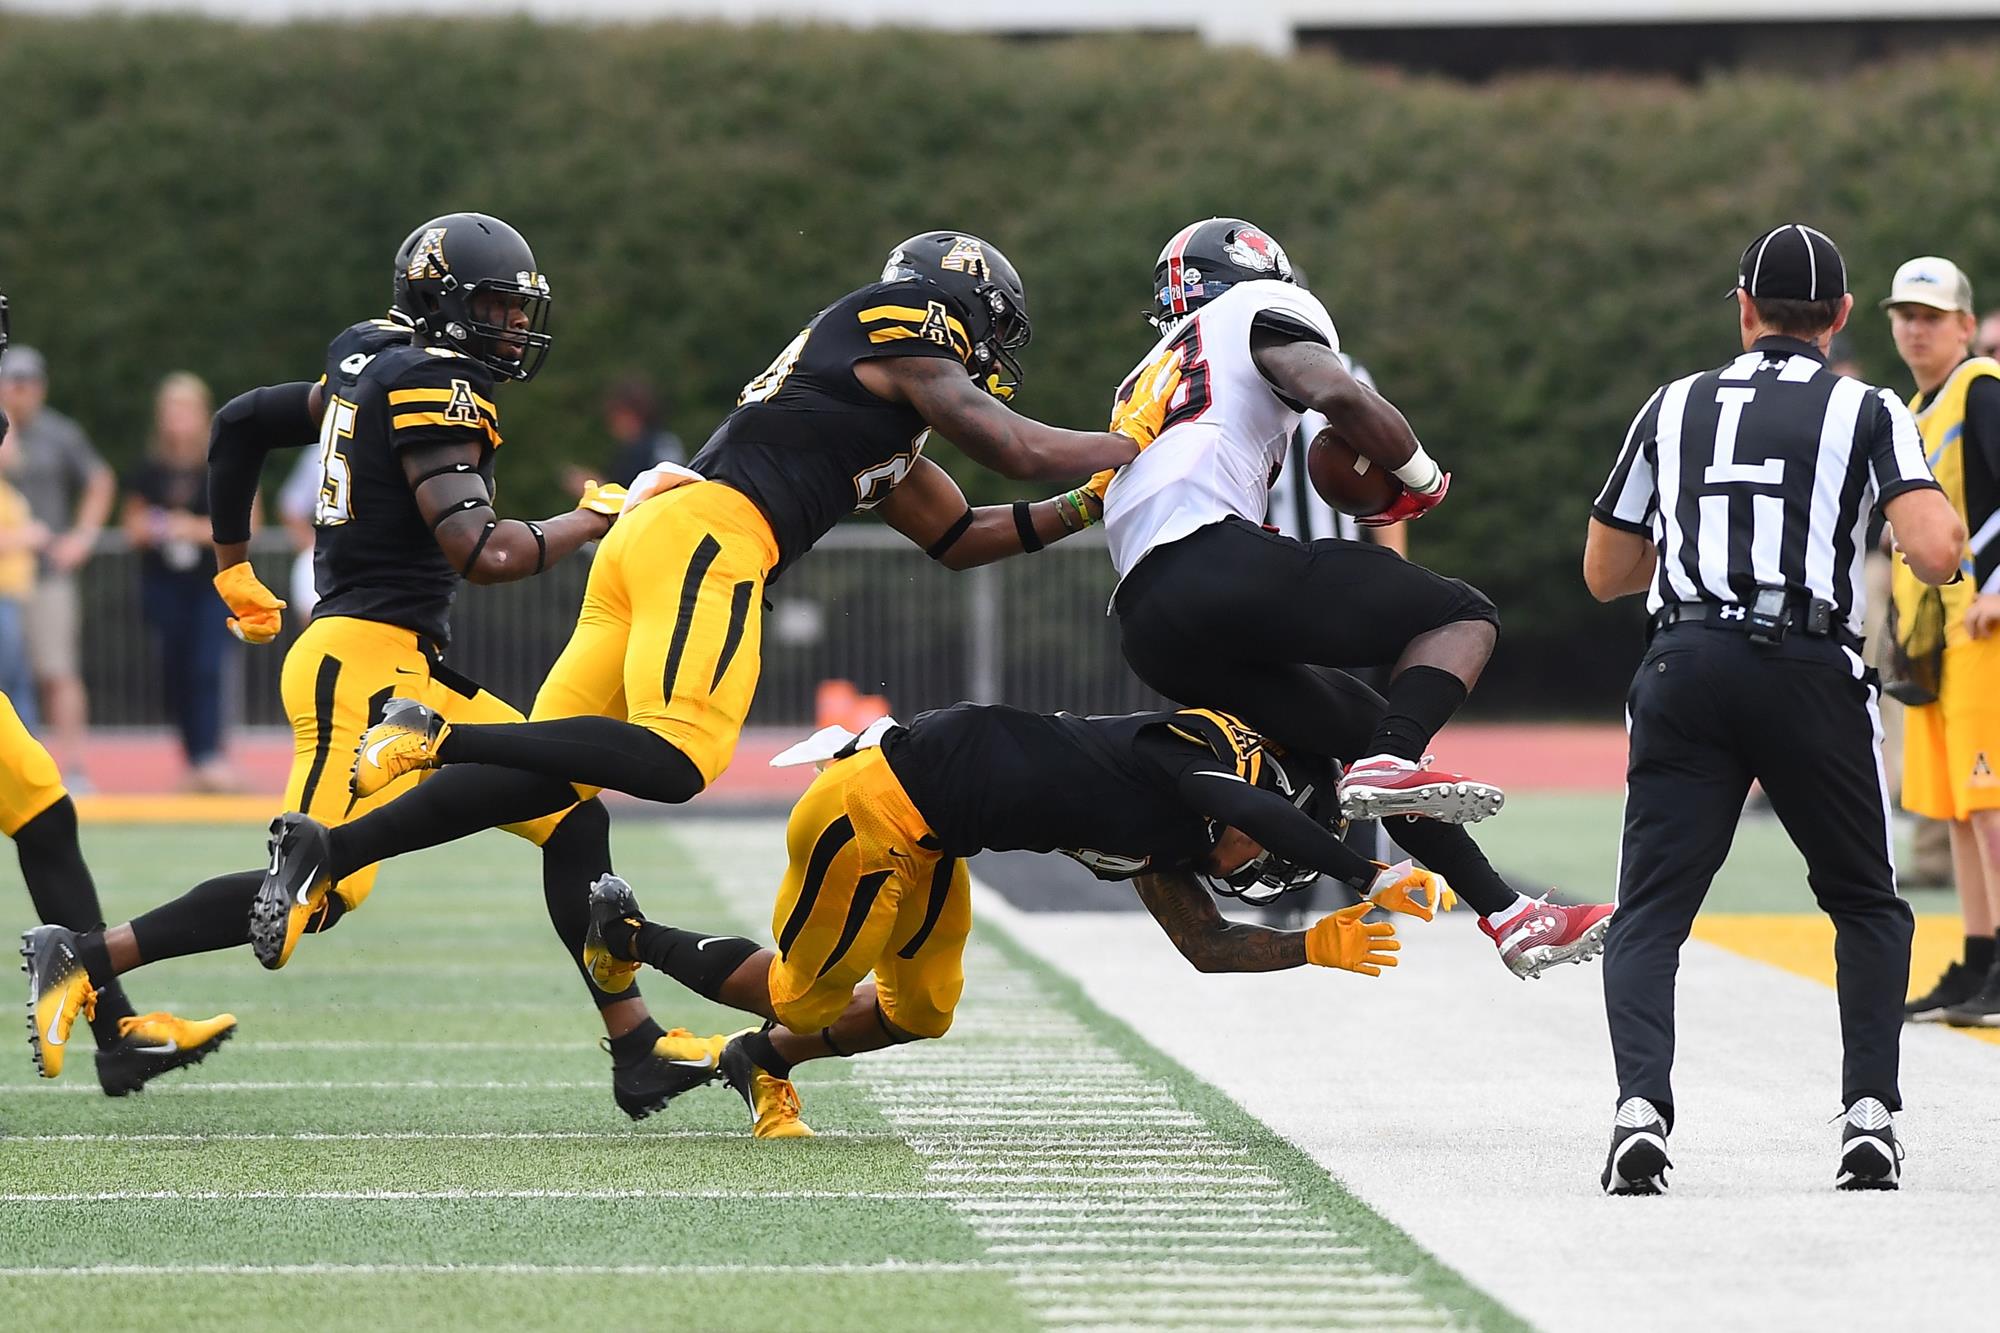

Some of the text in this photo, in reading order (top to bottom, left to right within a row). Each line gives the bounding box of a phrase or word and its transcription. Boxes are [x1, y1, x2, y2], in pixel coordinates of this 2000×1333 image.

[1172, 284, 1181, 300] 28
[919, 300, 954, 347] A
[445, 379, 480, 422] A
[1704, 387, 1785, 484] L
